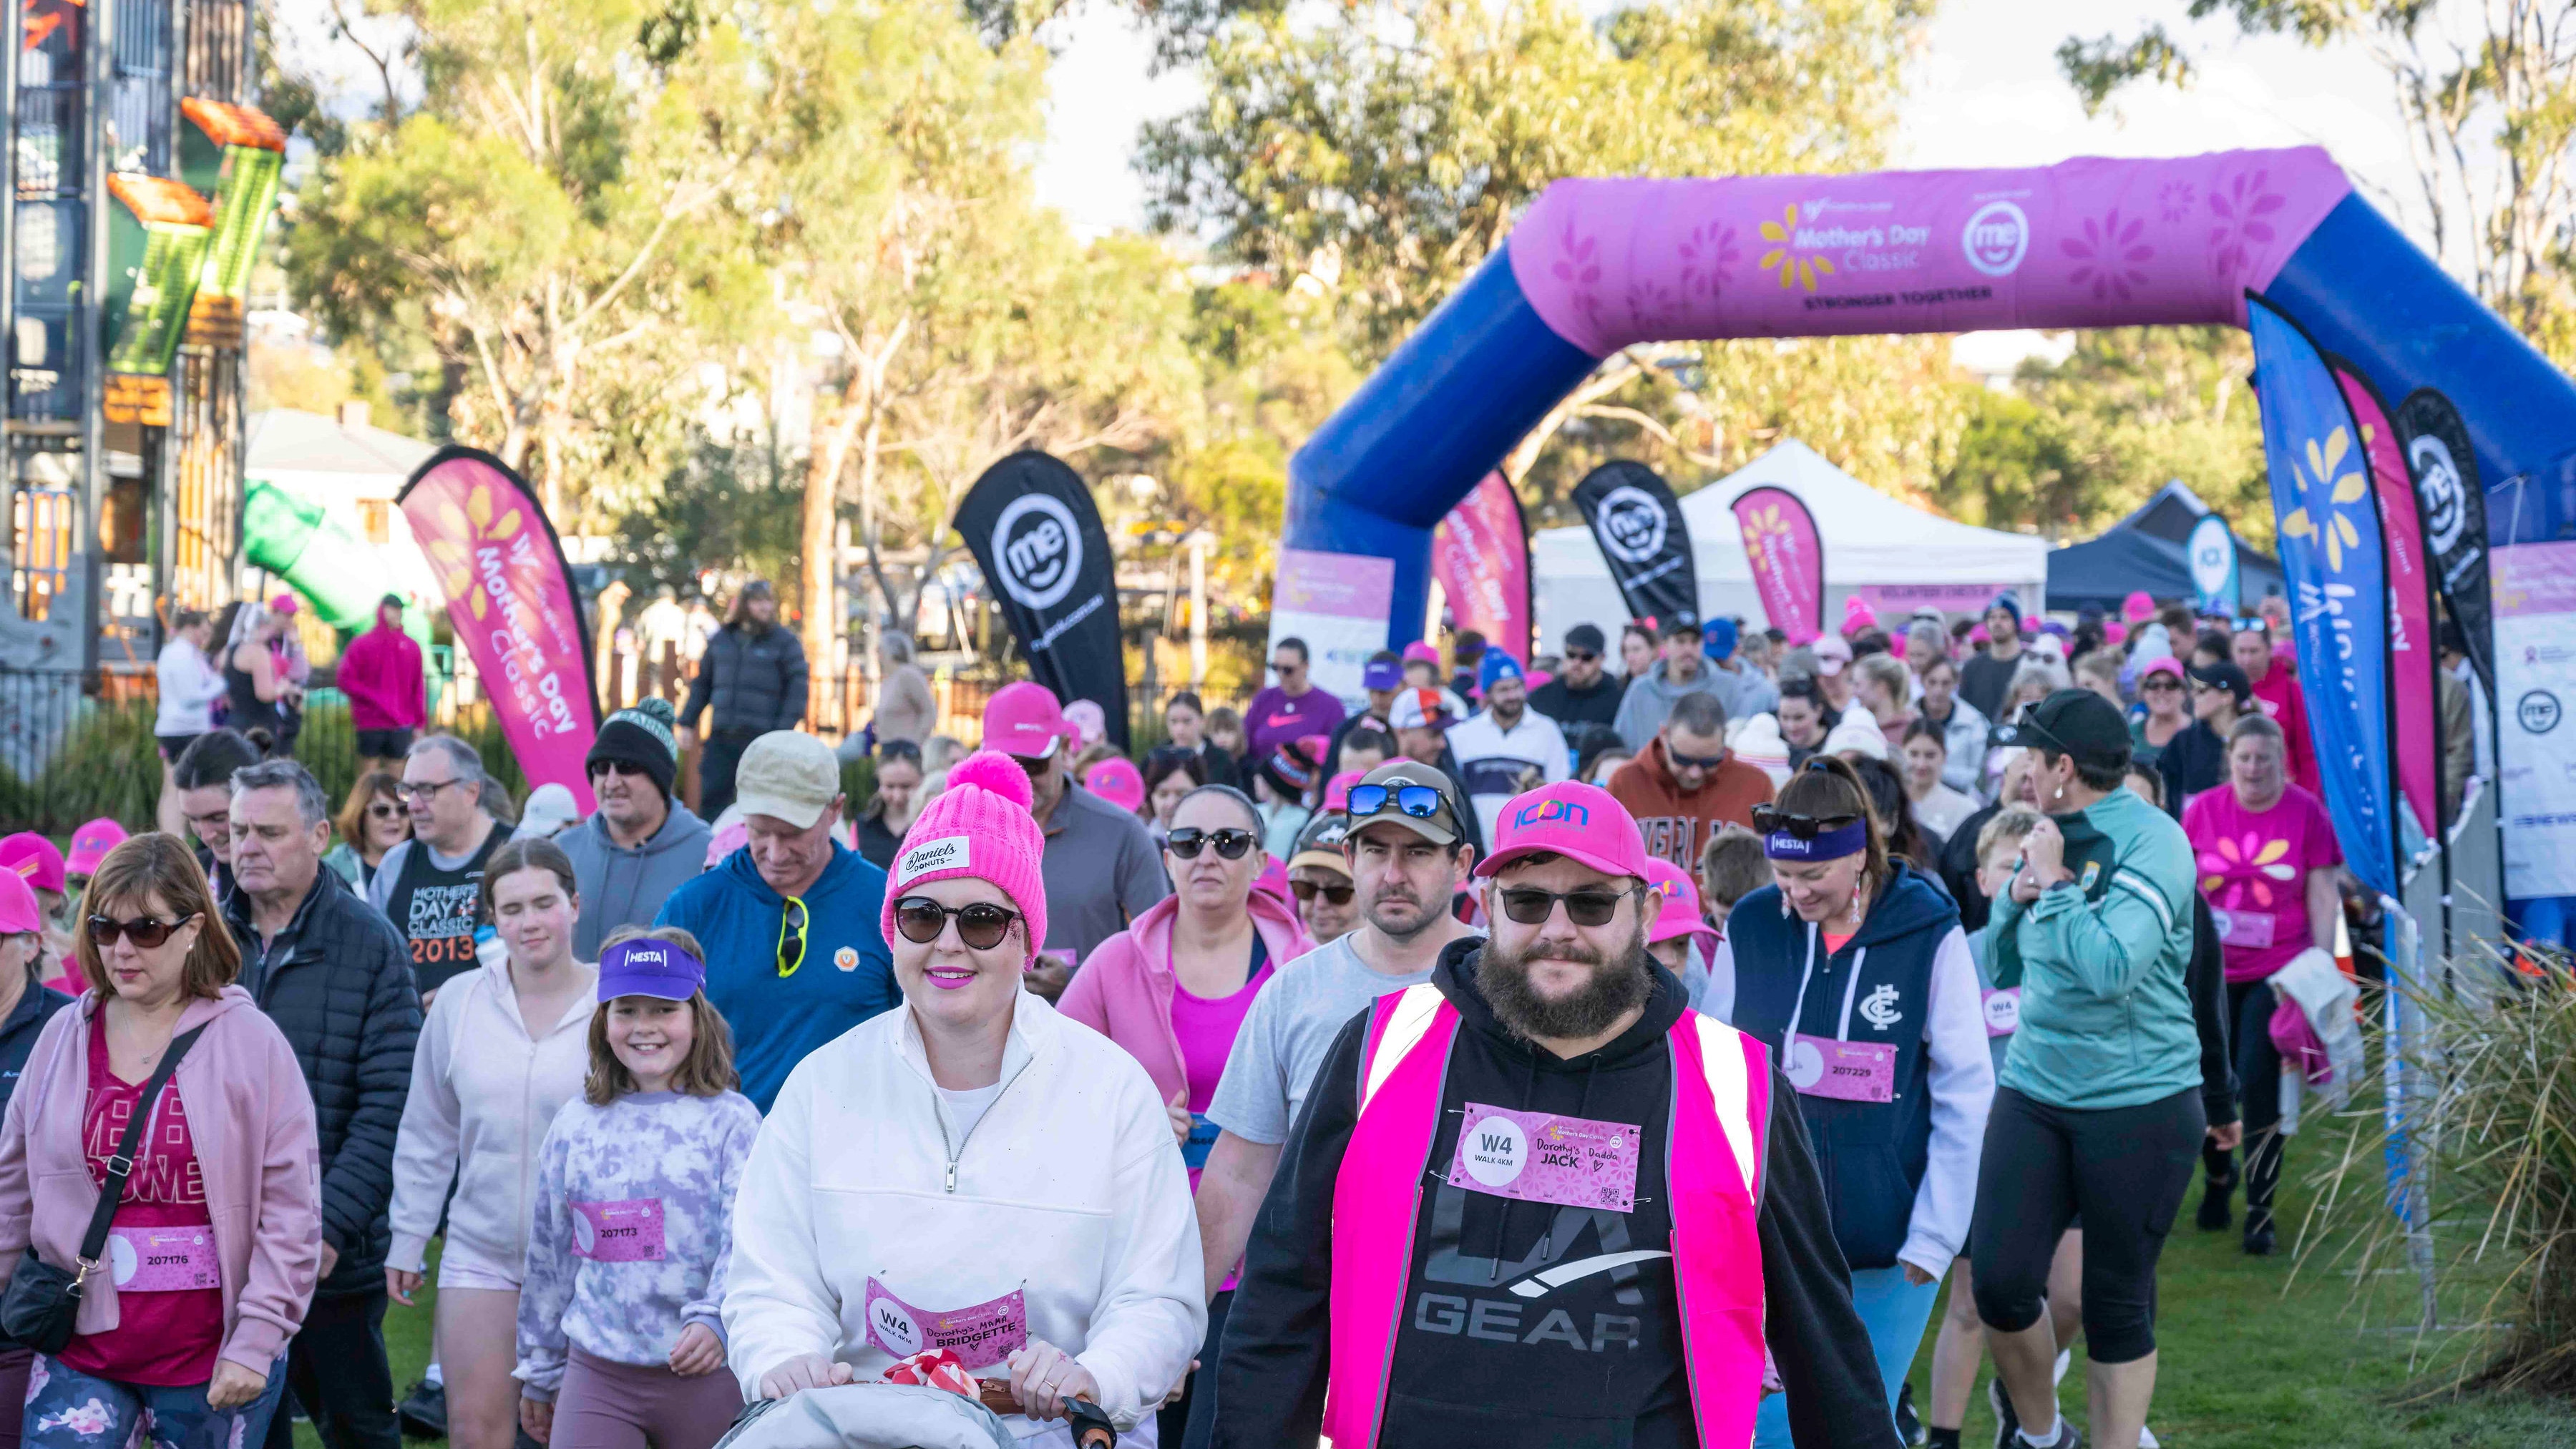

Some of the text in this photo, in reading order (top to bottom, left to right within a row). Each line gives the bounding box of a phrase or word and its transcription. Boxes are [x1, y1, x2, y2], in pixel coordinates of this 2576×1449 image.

[1793, 224, 1931, 248] Mother's Day
[1976, 223, 2017, 247] me
[1843, 250, 1920, 271] Classic
[1804, 286, 1994, 311] STRONGER TOGETHER
[1007, 519, 1066, 580] me
[476, 546, 546, 675] Mother's
[538, 671, 577, 735] Day
[492, 628, 550, 741] Classic
[1775, 837, 1806, 851] HESTA
[906, 843, 957, 871] Daniel's
[914, 858, 945, 872] DONUTS
[413, 882, 479, 902] MOTHER'S
[409, 899, 457, 920] DAY
[408, 915, 476, 933] CLASSIC
[409, 935, 474, 964] 2013
[630, 951, 662, 963] HESTA
[1833, 1066, 1872, 1077] 207229
[1481, 1133, 1513, 1155] W4
[1537, 1138, 1619, 1161] Dorothy's Dadda
[1475, 1154, 1513, 1166] WALK 4KM
[1541, 1153, 1580, 1169] JACK
[600, 1227, 638, 1239] 207173
[147, 1255, 189, 1265] 207176
[880, 1308, 909, 1335] W4
[927, 1316, 1008, 1338] Dorothy's MAMA
[1415, 1292, 1641, 1353] GEAR
[879, 1323, 912, 1345] WALK 4KM
[936, 1322, 1016, 1347] BRIDGETTE
